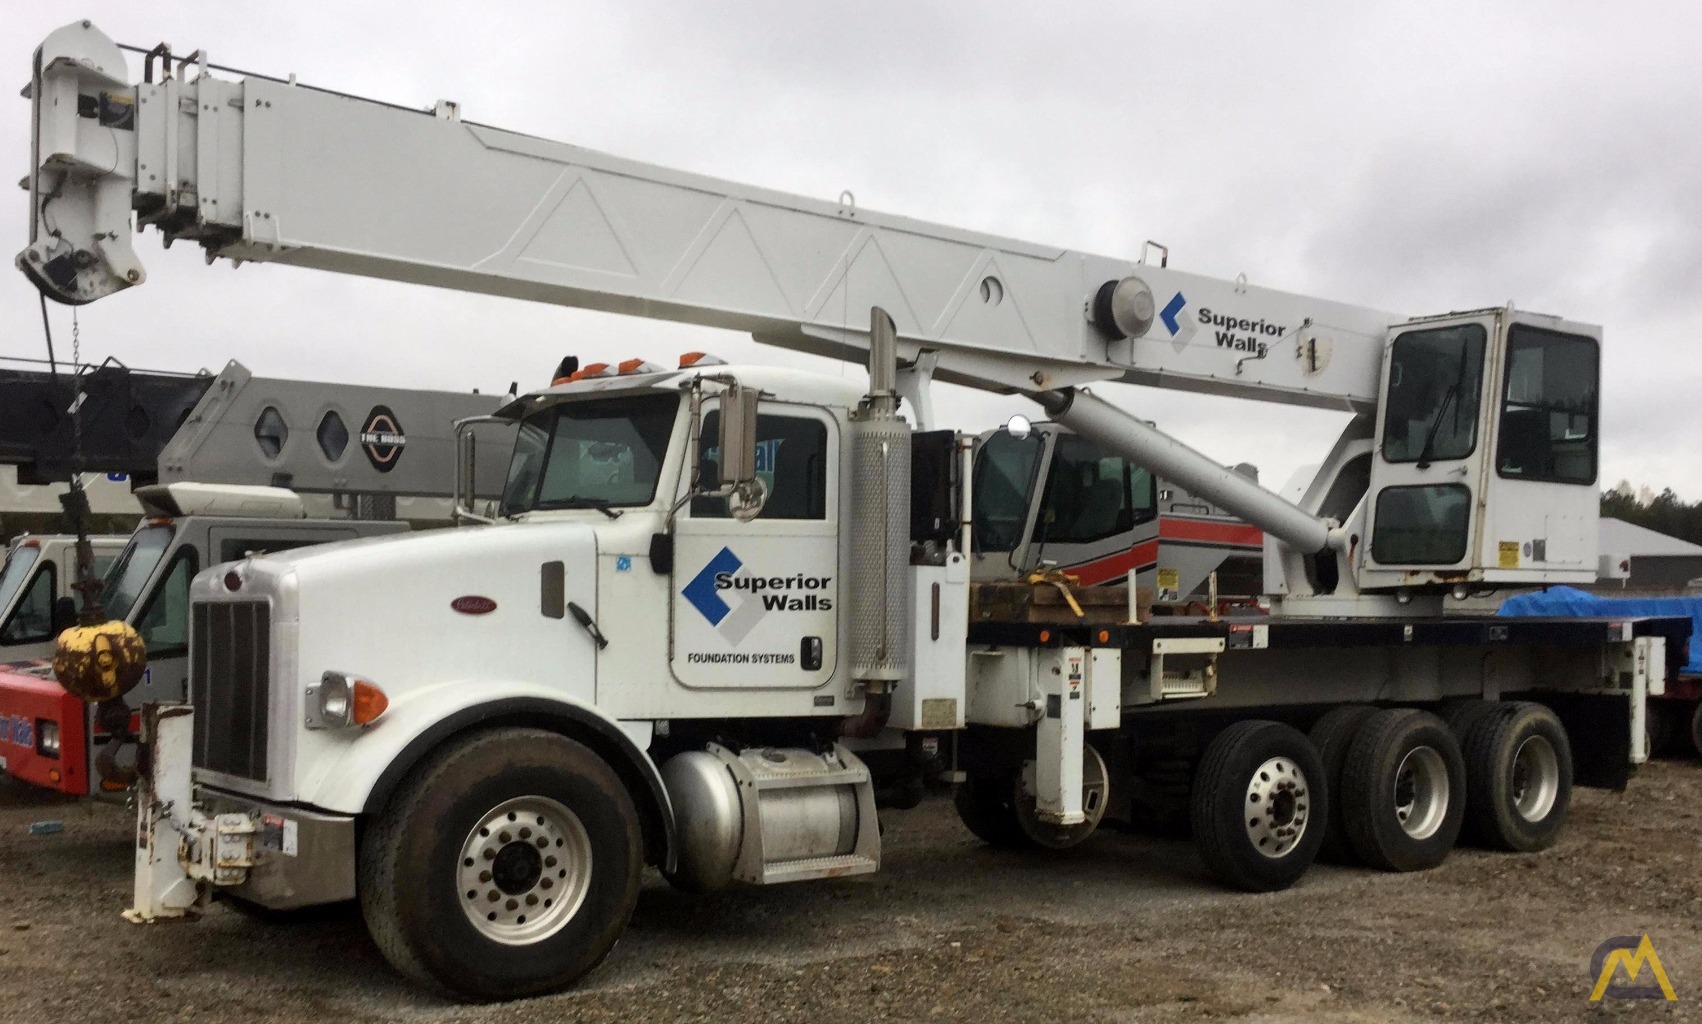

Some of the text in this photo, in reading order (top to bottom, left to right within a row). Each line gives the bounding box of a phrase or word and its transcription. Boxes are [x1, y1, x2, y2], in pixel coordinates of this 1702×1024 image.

[1198, 307, 1286, 337] Superior
[1215, 331, 1268, 354] Walls
[714, 572, 832, 594] Superior
[762, 594, 833, 611] Walls
[687, 653, 795, 664] FOUNDATION SYSTEMS
